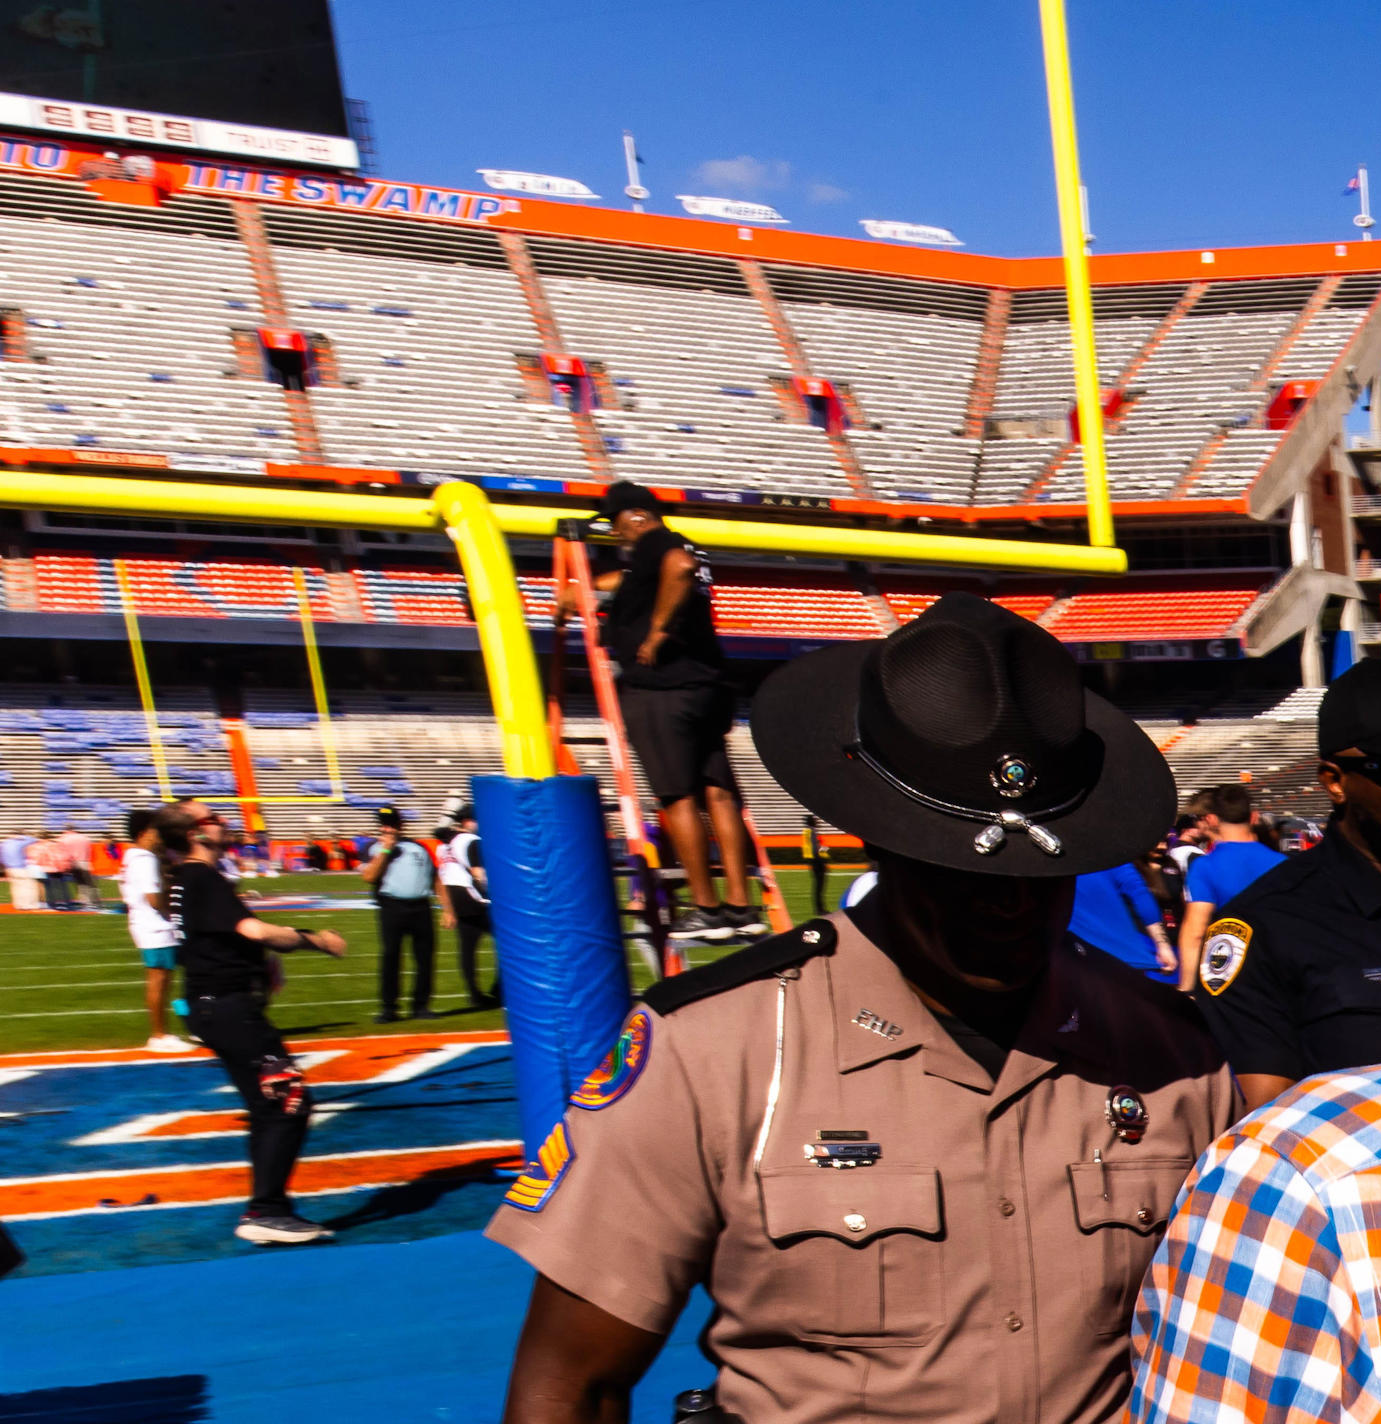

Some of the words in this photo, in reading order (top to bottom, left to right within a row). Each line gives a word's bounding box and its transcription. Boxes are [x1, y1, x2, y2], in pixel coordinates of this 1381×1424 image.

[183, 158, 288, 197] THE
[292, 174, 506, 225] SWAMP
[851, 1008, 904, 1041] FHP
